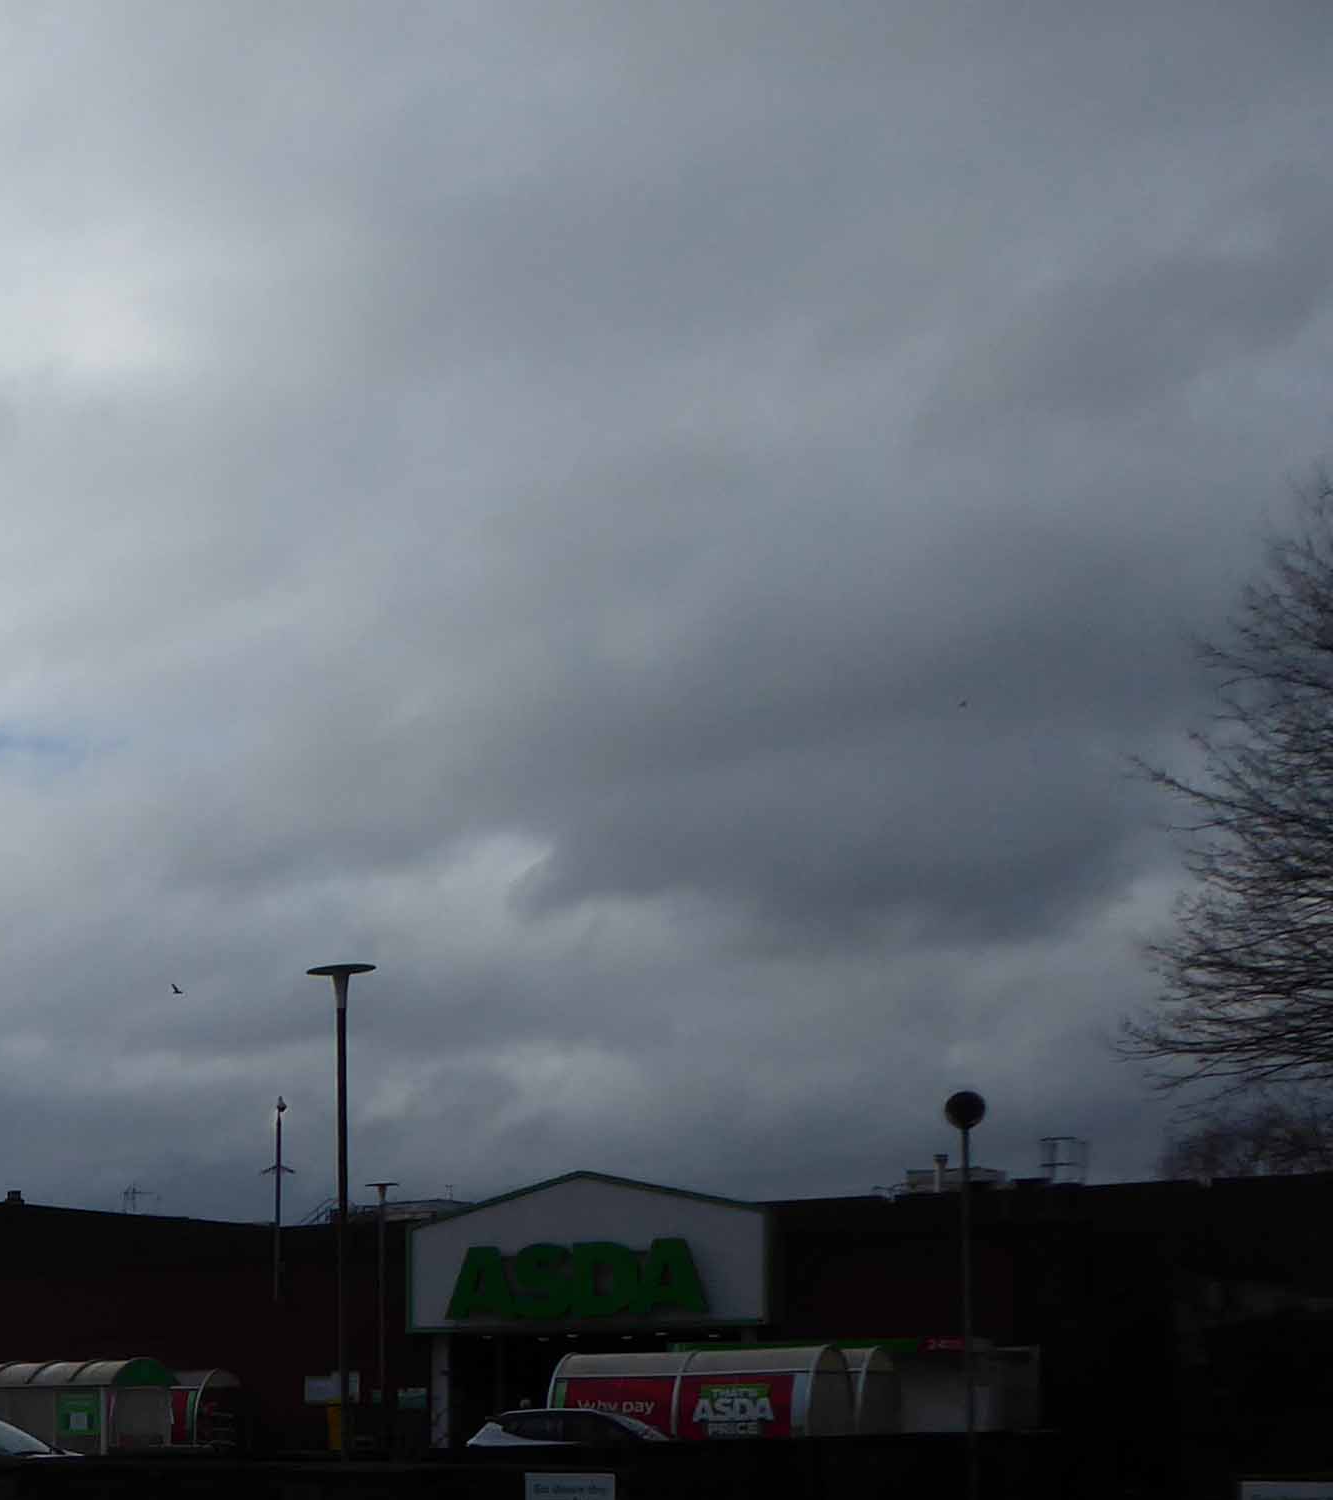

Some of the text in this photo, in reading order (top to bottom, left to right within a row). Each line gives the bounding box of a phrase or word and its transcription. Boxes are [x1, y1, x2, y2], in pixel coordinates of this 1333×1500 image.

[445, 1238, 710, 1321] ASDA
[622, 1401, 655, 1416] pay
[692, 1397, 774, 1422] ASDA
[708, 1422, 758, 1437] PRICE
